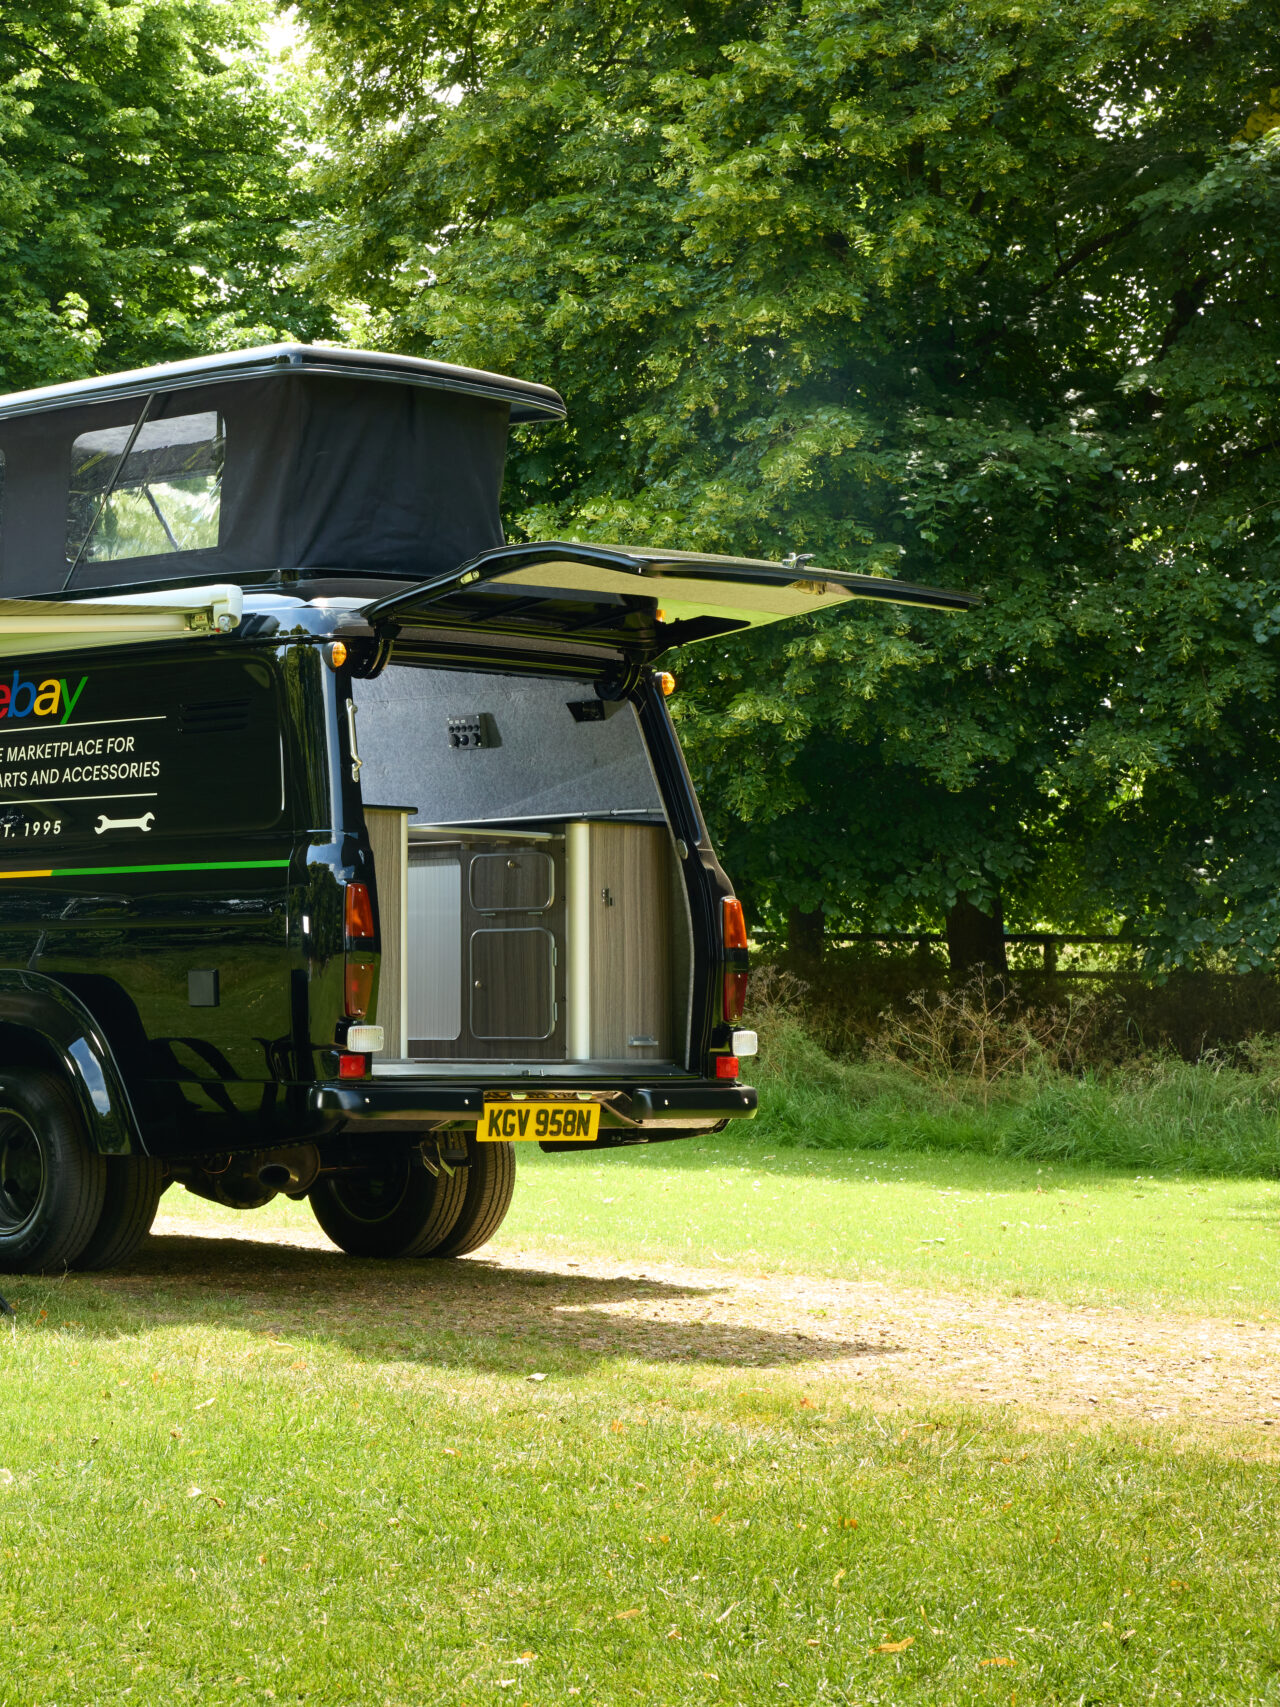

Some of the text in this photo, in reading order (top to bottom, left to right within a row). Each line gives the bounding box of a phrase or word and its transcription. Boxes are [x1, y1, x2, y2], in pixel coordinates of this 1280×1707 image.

[6, 739, 104, 762] MARKETPLACE
[106, 736, 135, 752] FOR
[30, 769, 60, 786] AND
[62, 761, 160, 783] ACCESSORIES
[24, 820, 62, 837] 1995
[488, 1108, 592, 1137] KGV 958N
